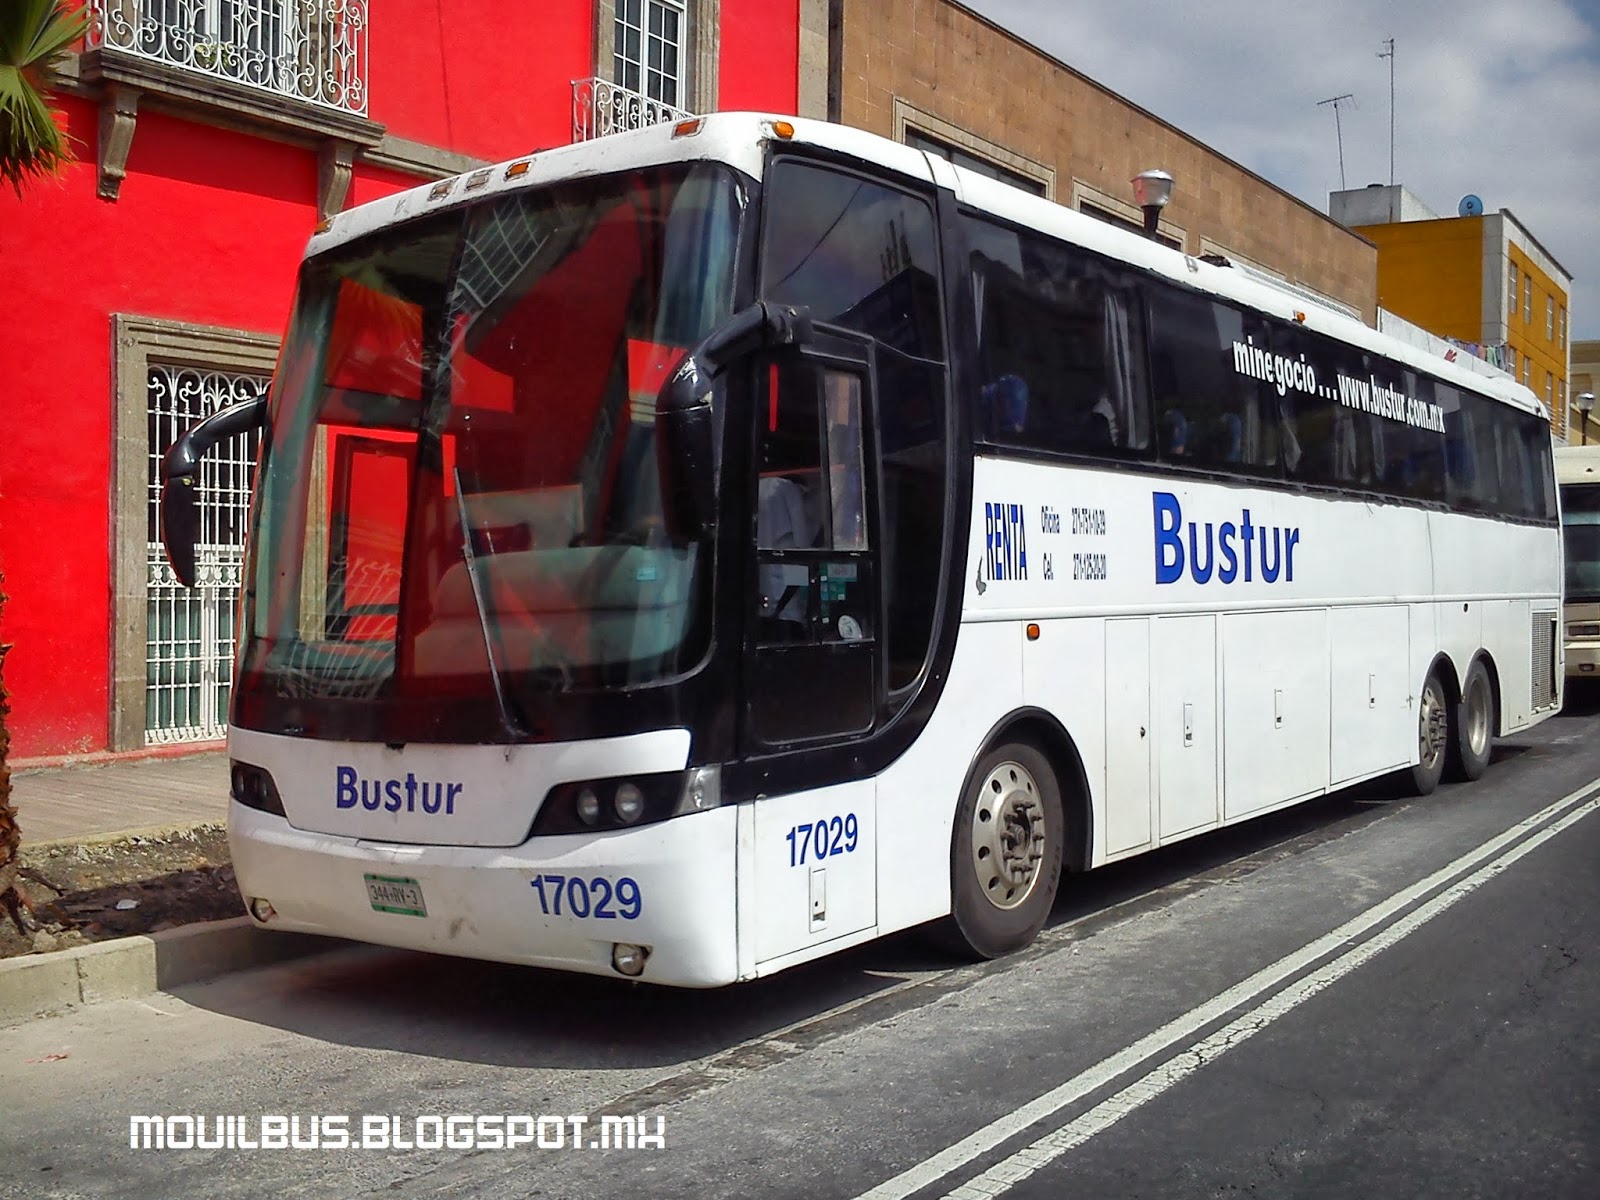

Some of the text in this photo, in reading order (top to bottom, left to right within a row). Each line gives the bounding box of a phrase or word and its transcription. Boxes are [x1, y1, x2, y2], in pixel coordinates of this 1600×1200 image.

[985, 502, 1028, 580] RENTA
[1041, 505, 1061, 534] Oficina
[1152, 491, 1299, 584] Bustur
[336, 766, 463, 815] Bustur
[786, 812, 858, 867] 17029
[530, 874, 642, 919] 17029
